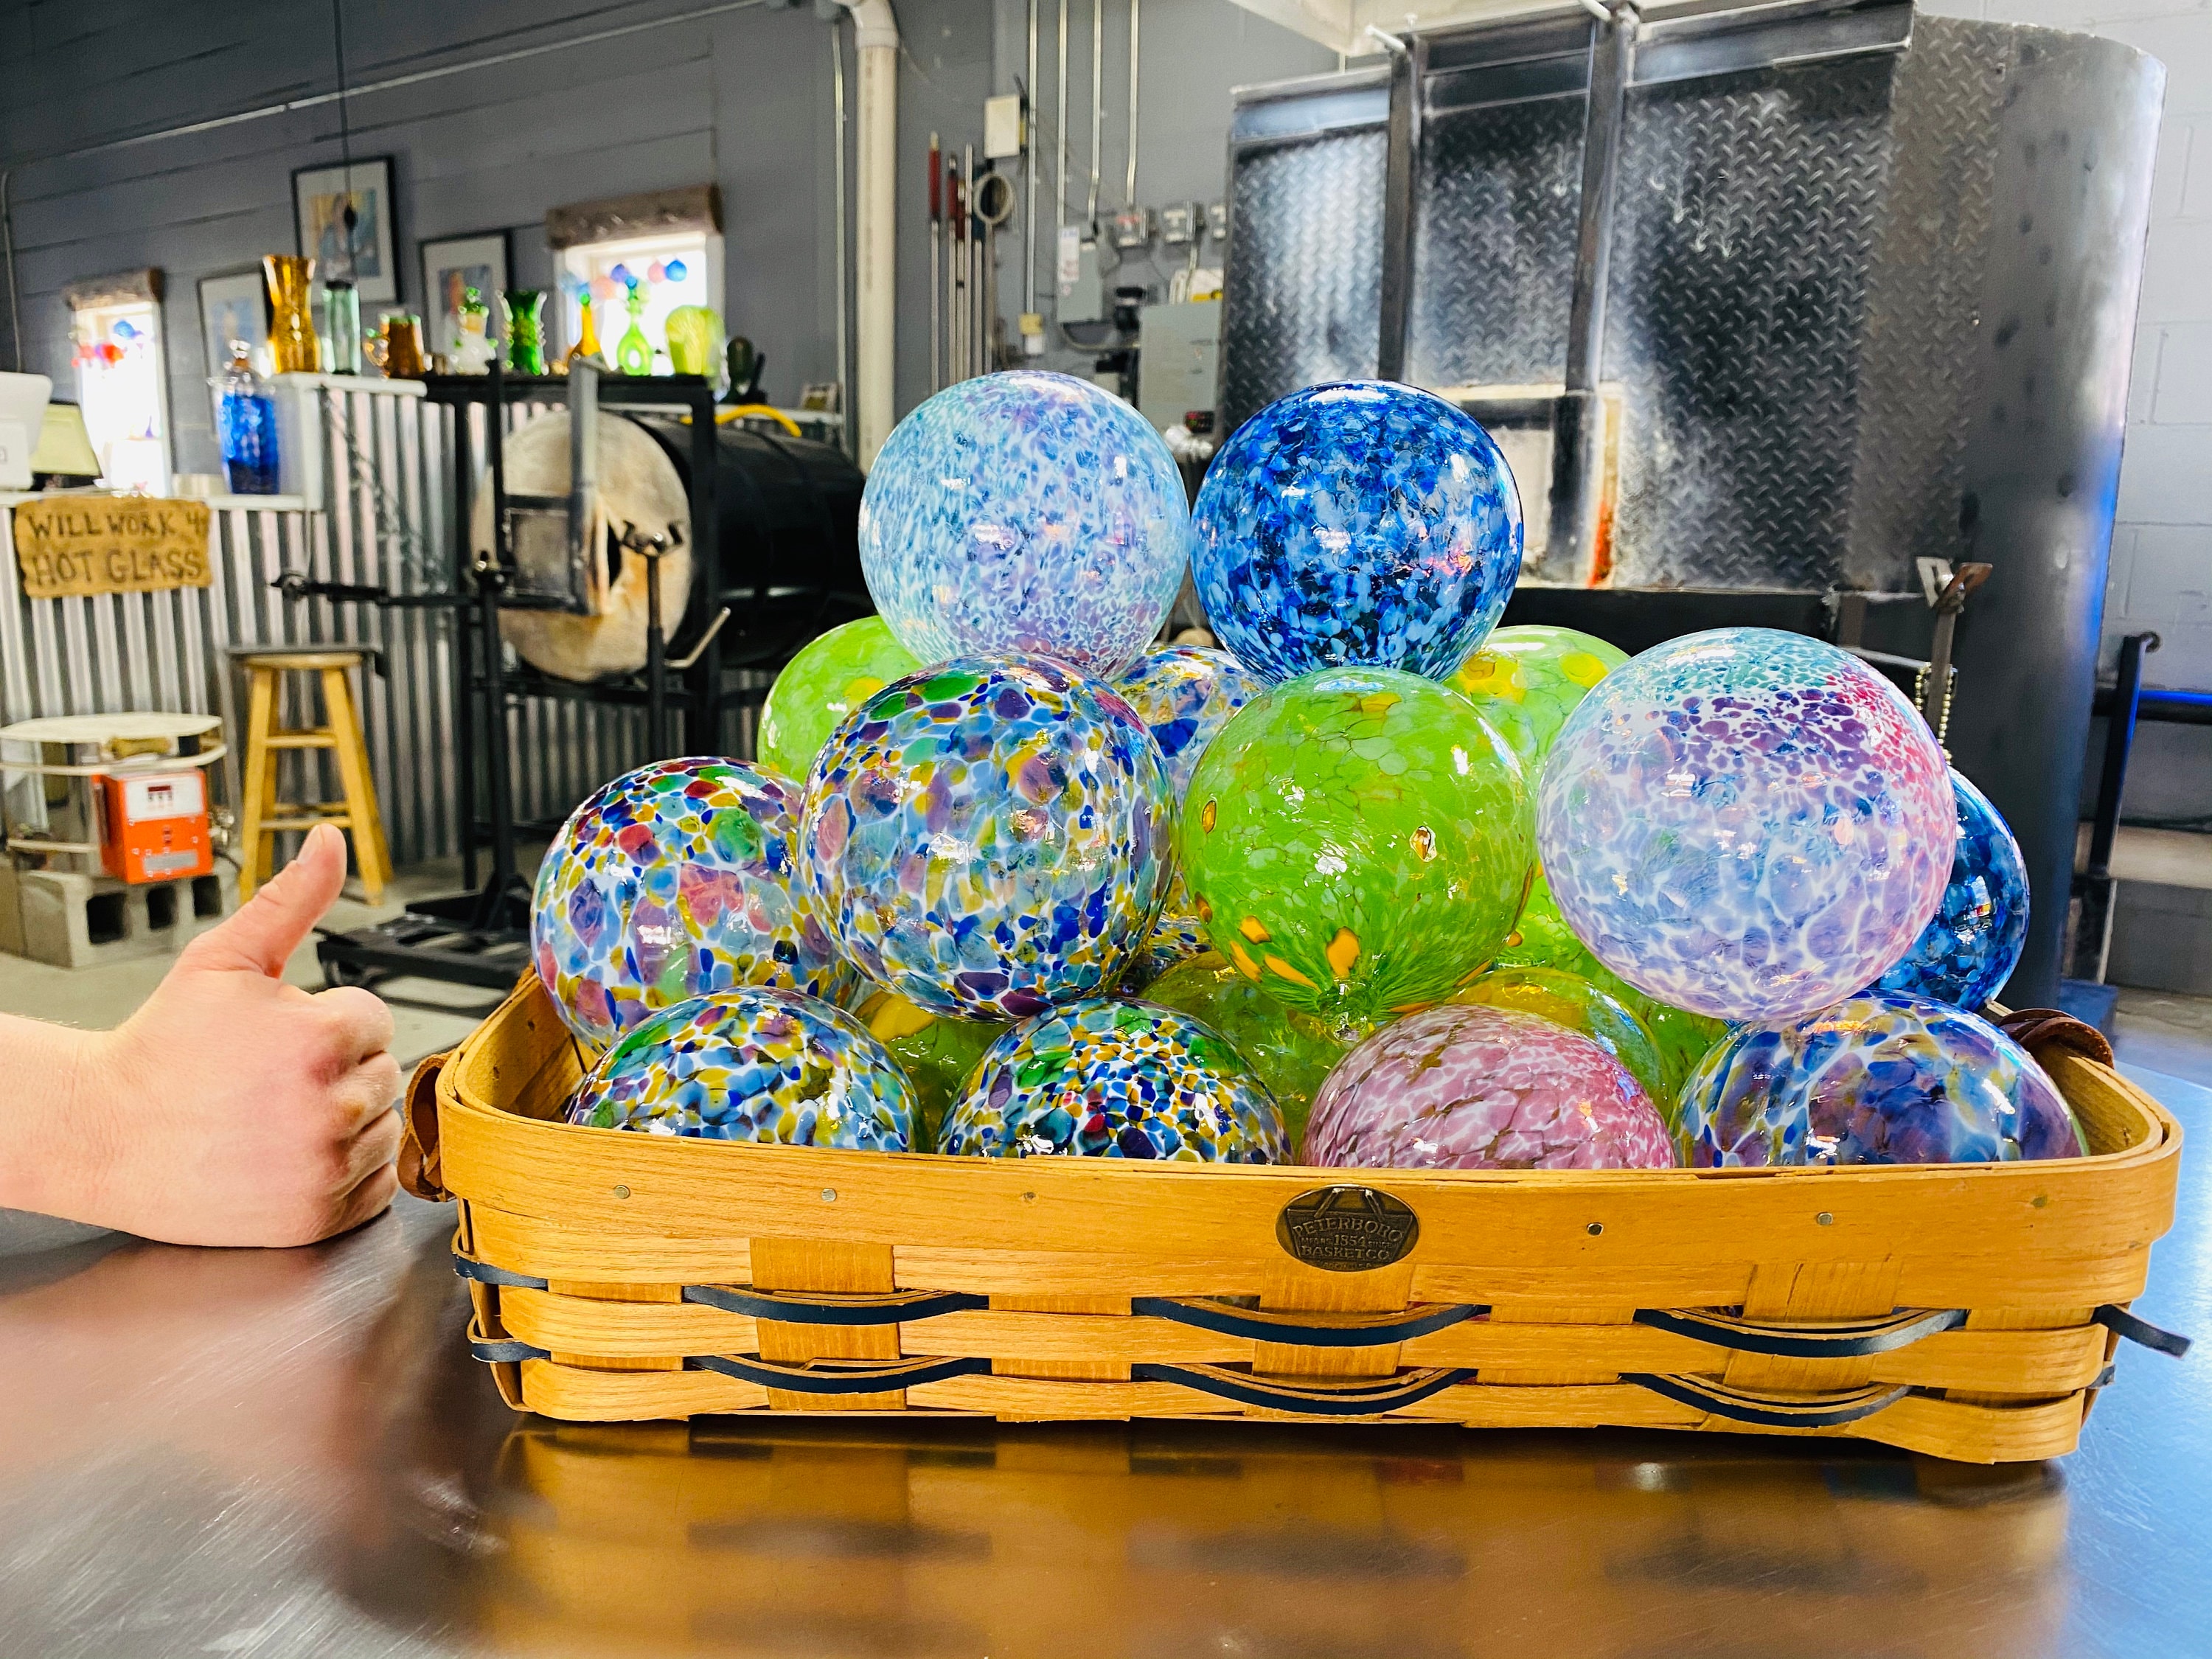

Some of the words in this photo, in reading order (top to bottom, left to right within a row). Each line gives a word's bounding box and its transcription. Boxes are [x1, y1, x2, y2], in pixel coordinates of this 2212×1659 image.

[27, 510, 102, 538] WILL
[107, 510, 178, 538] WORK
[32, 550, 94, 587] HOT
[105, 548, 202, 584] GLASS
[1293, 1217, 1403, 1242] PETERBORO
[1334, 1234, 1366, 1247] 1854
[1301, 1245, 1365, 1259] BASKET
